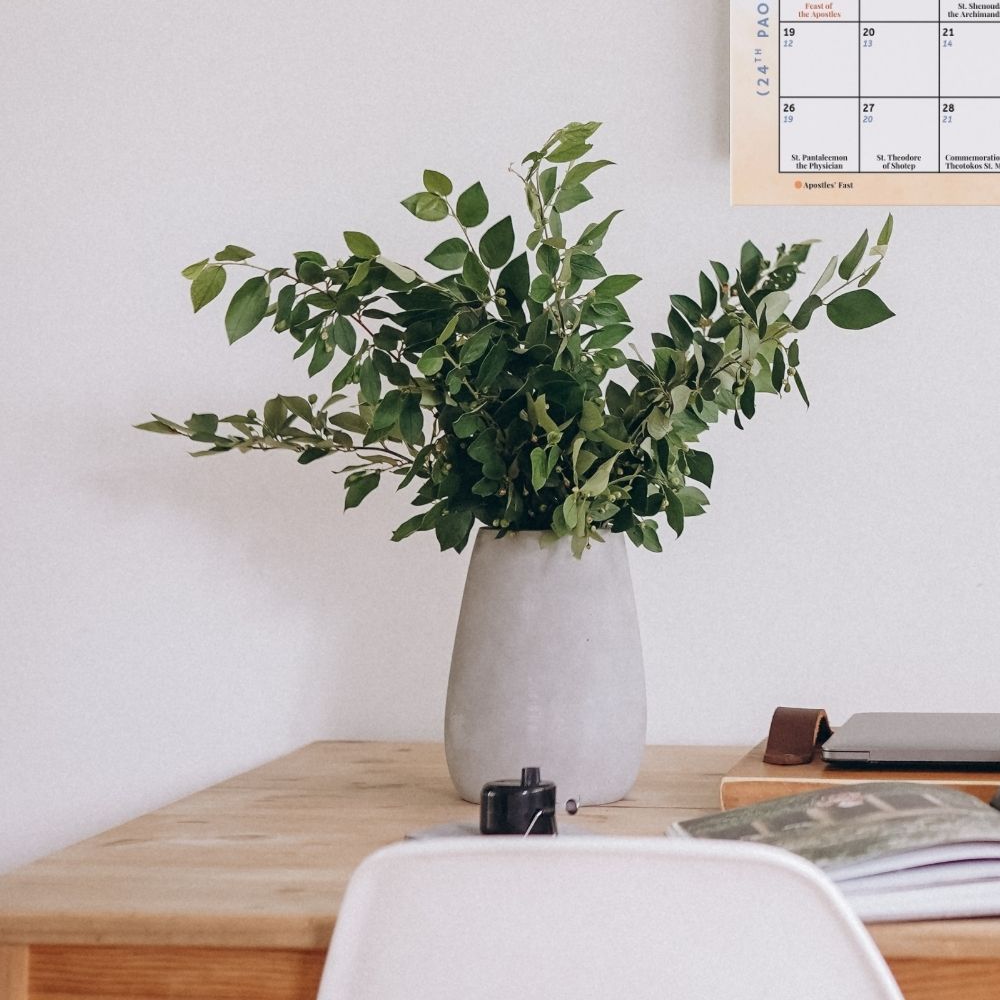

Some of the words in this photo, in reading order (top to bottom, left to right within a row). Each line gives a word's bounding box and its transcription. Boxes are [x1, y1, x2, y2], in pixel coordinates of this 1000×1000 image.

[824, 2, 833, 10] of
[810, 10, 841, 20] Apostles
[862, 27, 875, 37] 20
[783, 103, 796, 113] 26
[803, 181, 837, 190] Apostles'
